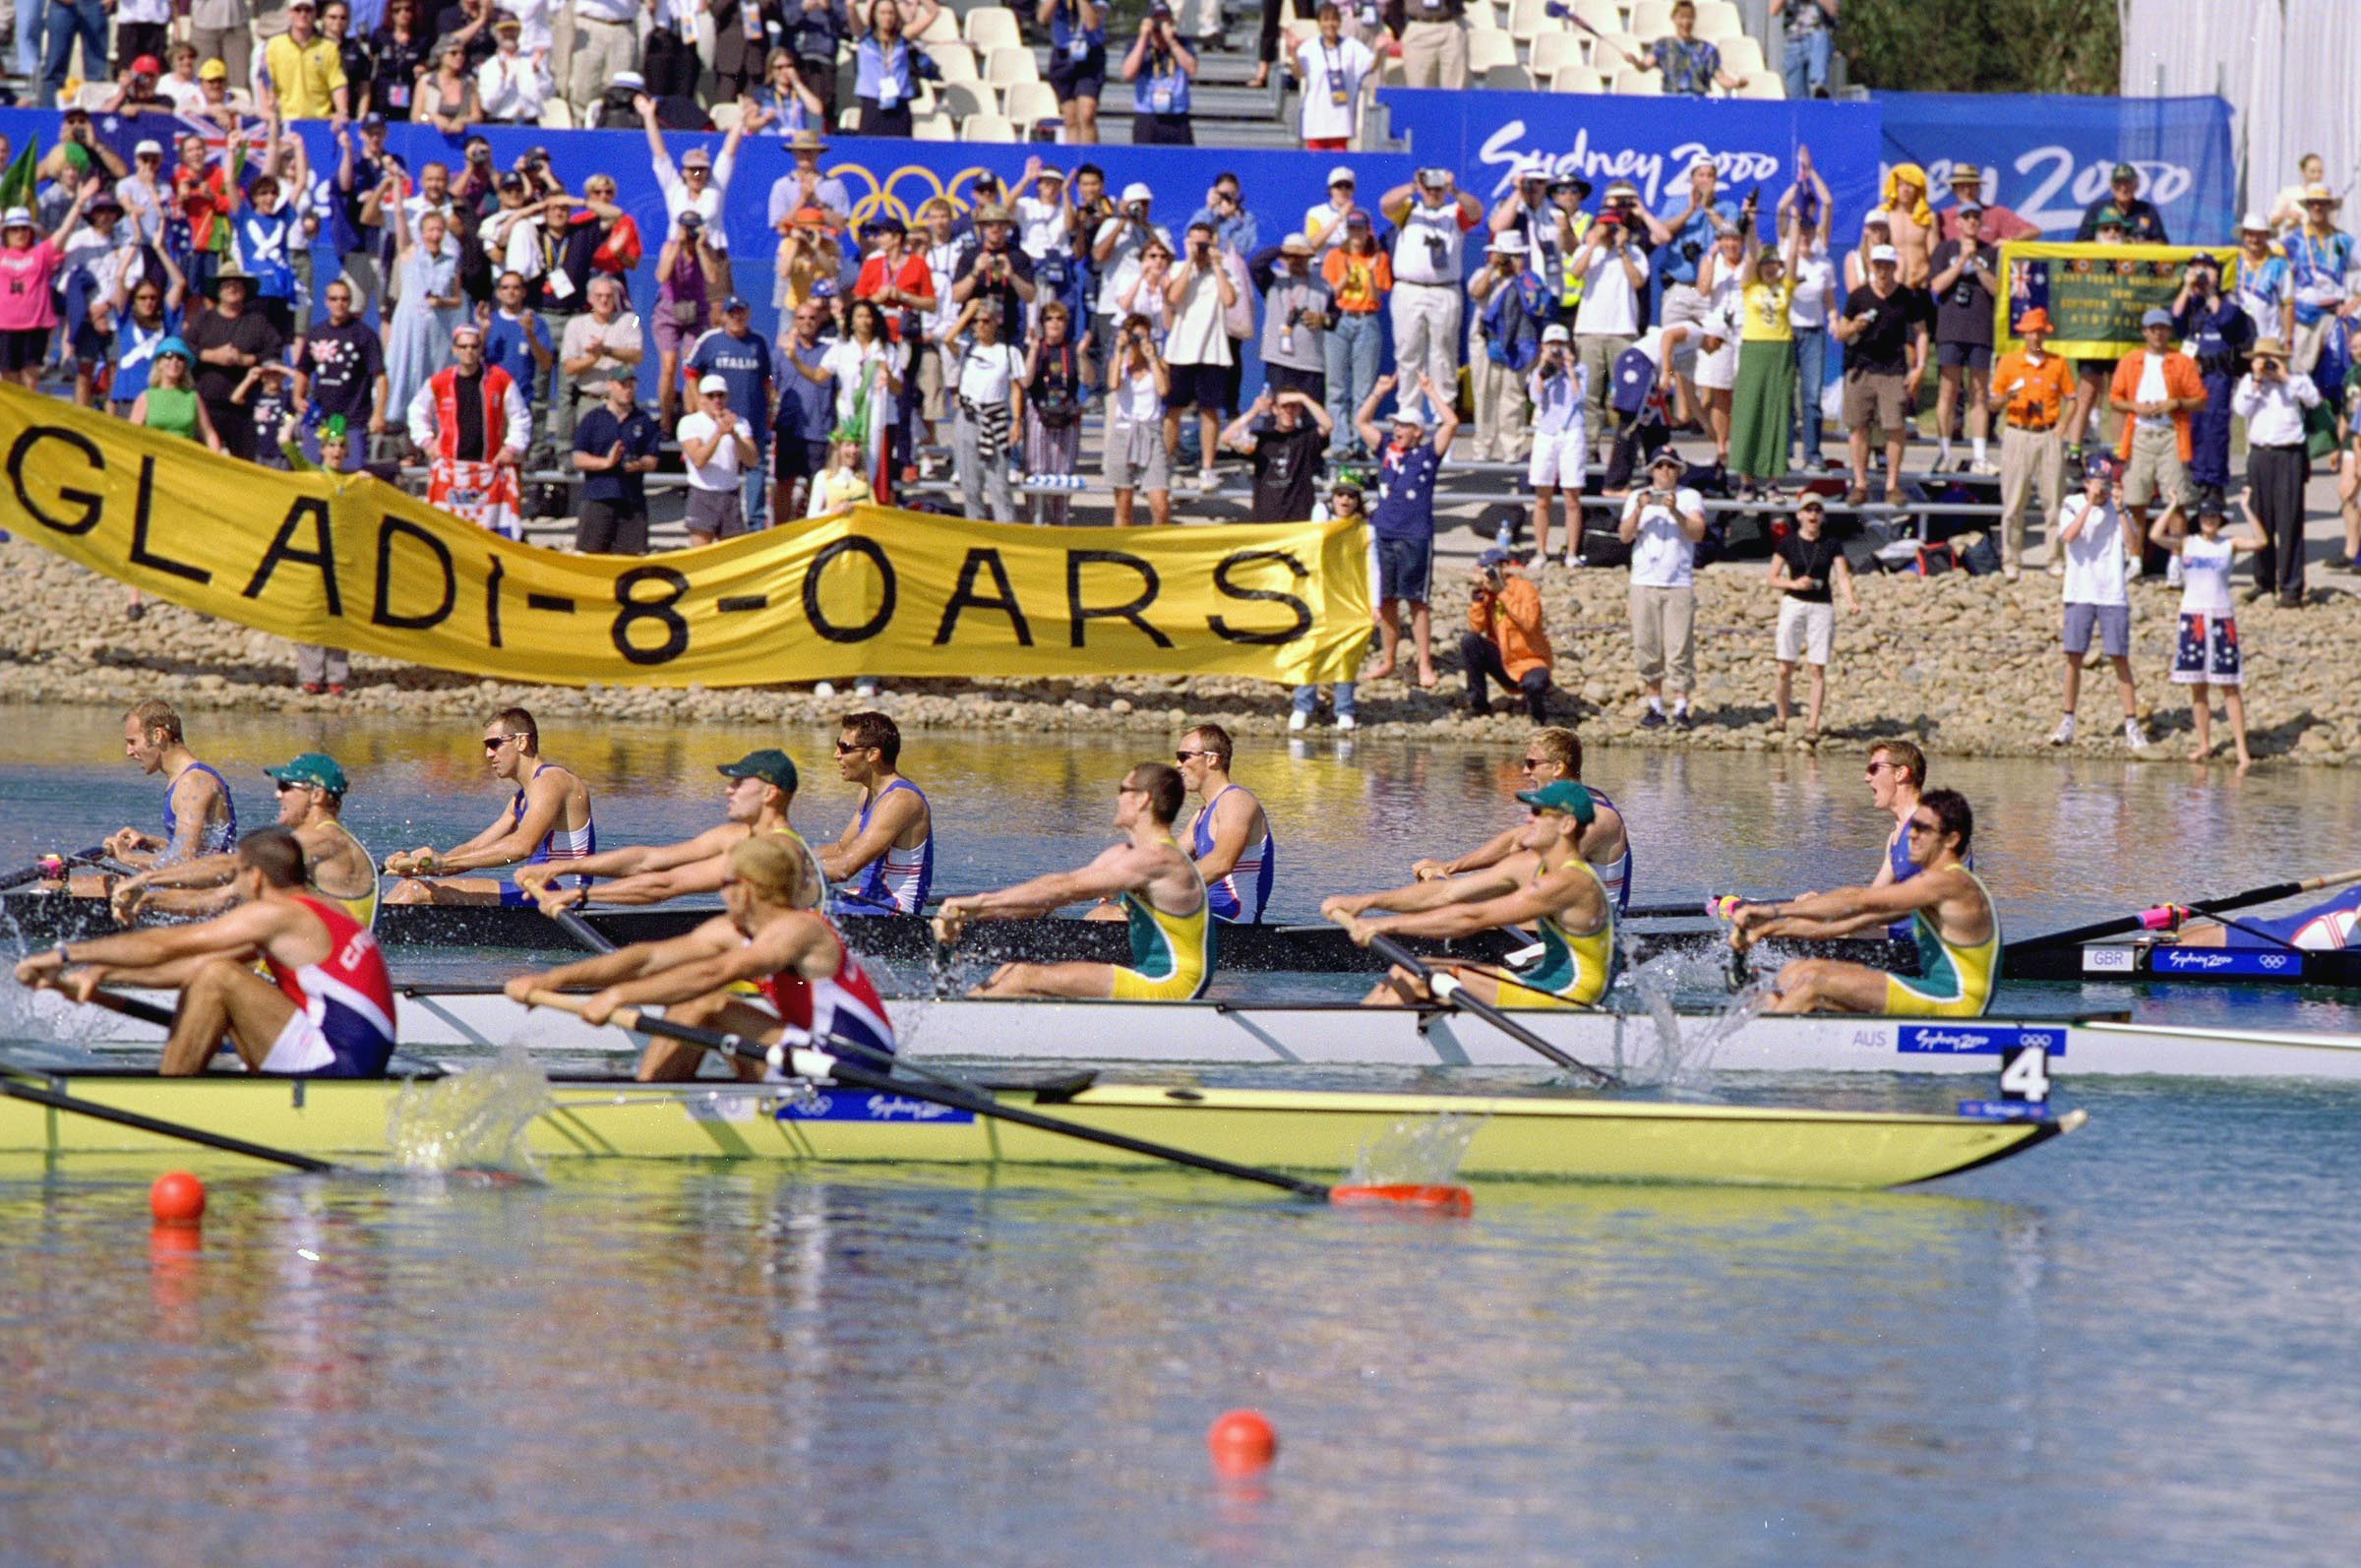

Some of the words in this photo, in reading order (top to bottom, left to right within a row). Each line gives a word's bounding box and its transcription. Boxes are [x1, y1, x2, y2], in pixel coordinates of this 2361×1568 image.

[2093, 951, 2124, 965] GBR
[2169, 950, 2208, 968] Sydney
[1853, 1032, 1886, 1047] AUS
[1914, 1029, 1960, 1052] Sydney
[2001, 1047, 2049, 1102] 4
